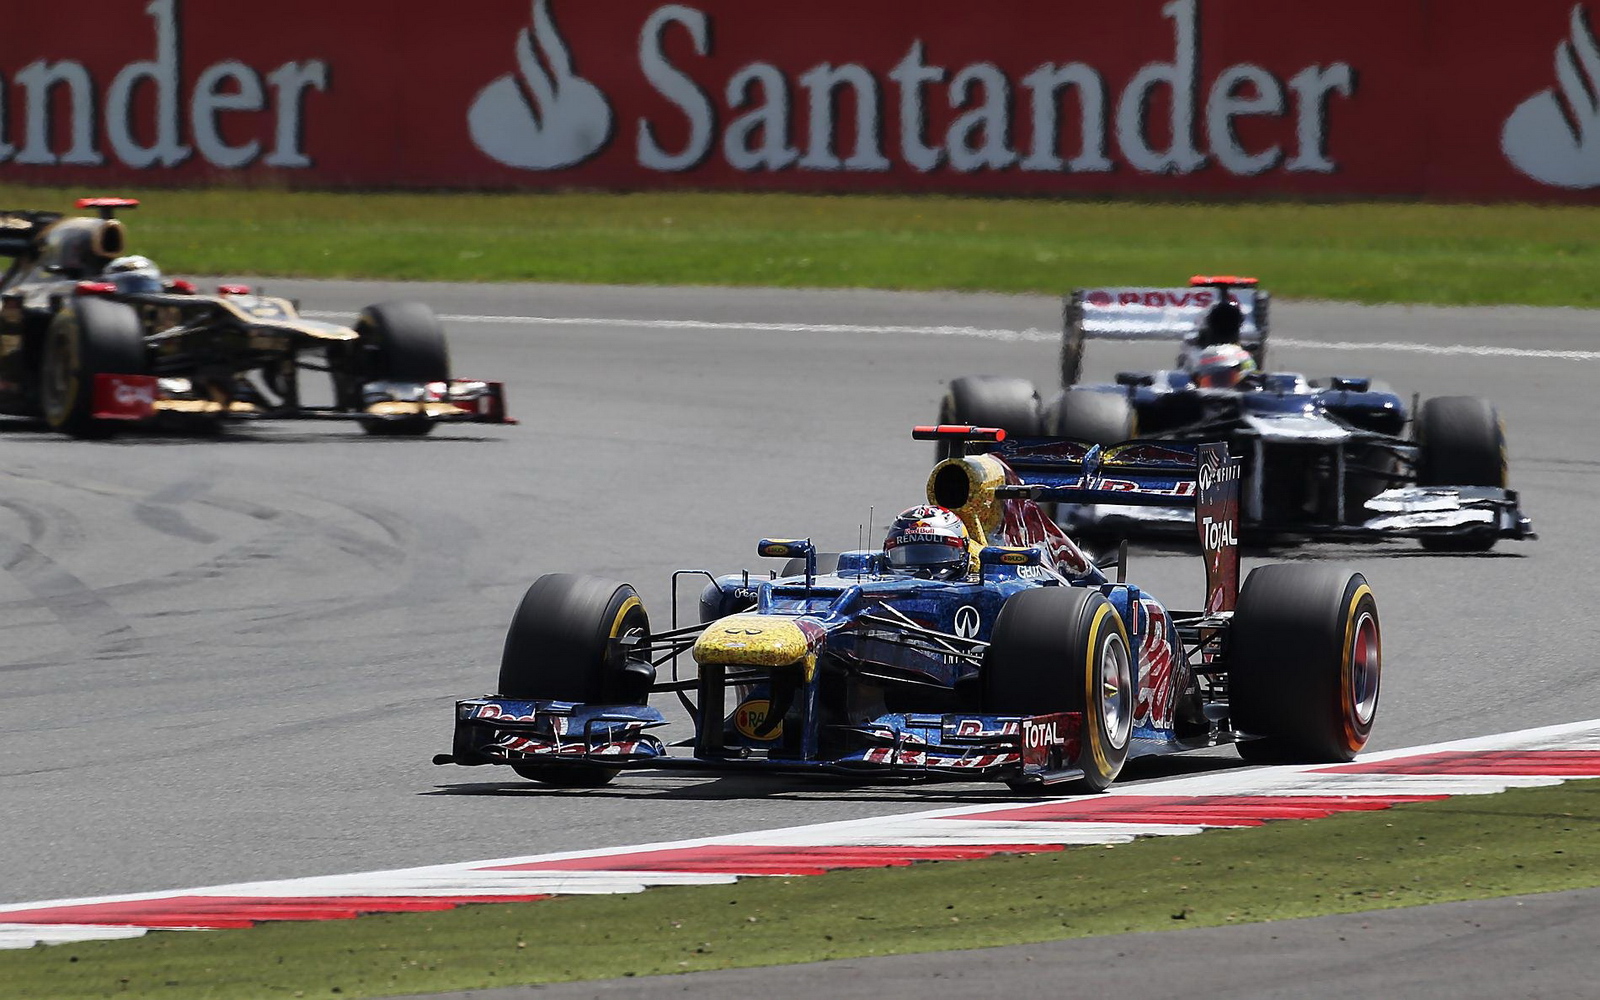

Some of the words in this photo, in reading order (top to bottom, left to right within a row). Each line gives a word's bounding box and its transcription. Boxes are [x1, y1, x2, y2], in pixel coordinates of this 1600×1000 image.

[0, 0, 328, 168] nder
[636, 0, 1352, 174] Santander
[896, 534, 943, 545] RENAULT
[1202, 516, 1238, 550] TOTAL
[1023, 720, 1064, 749] TOTAL
